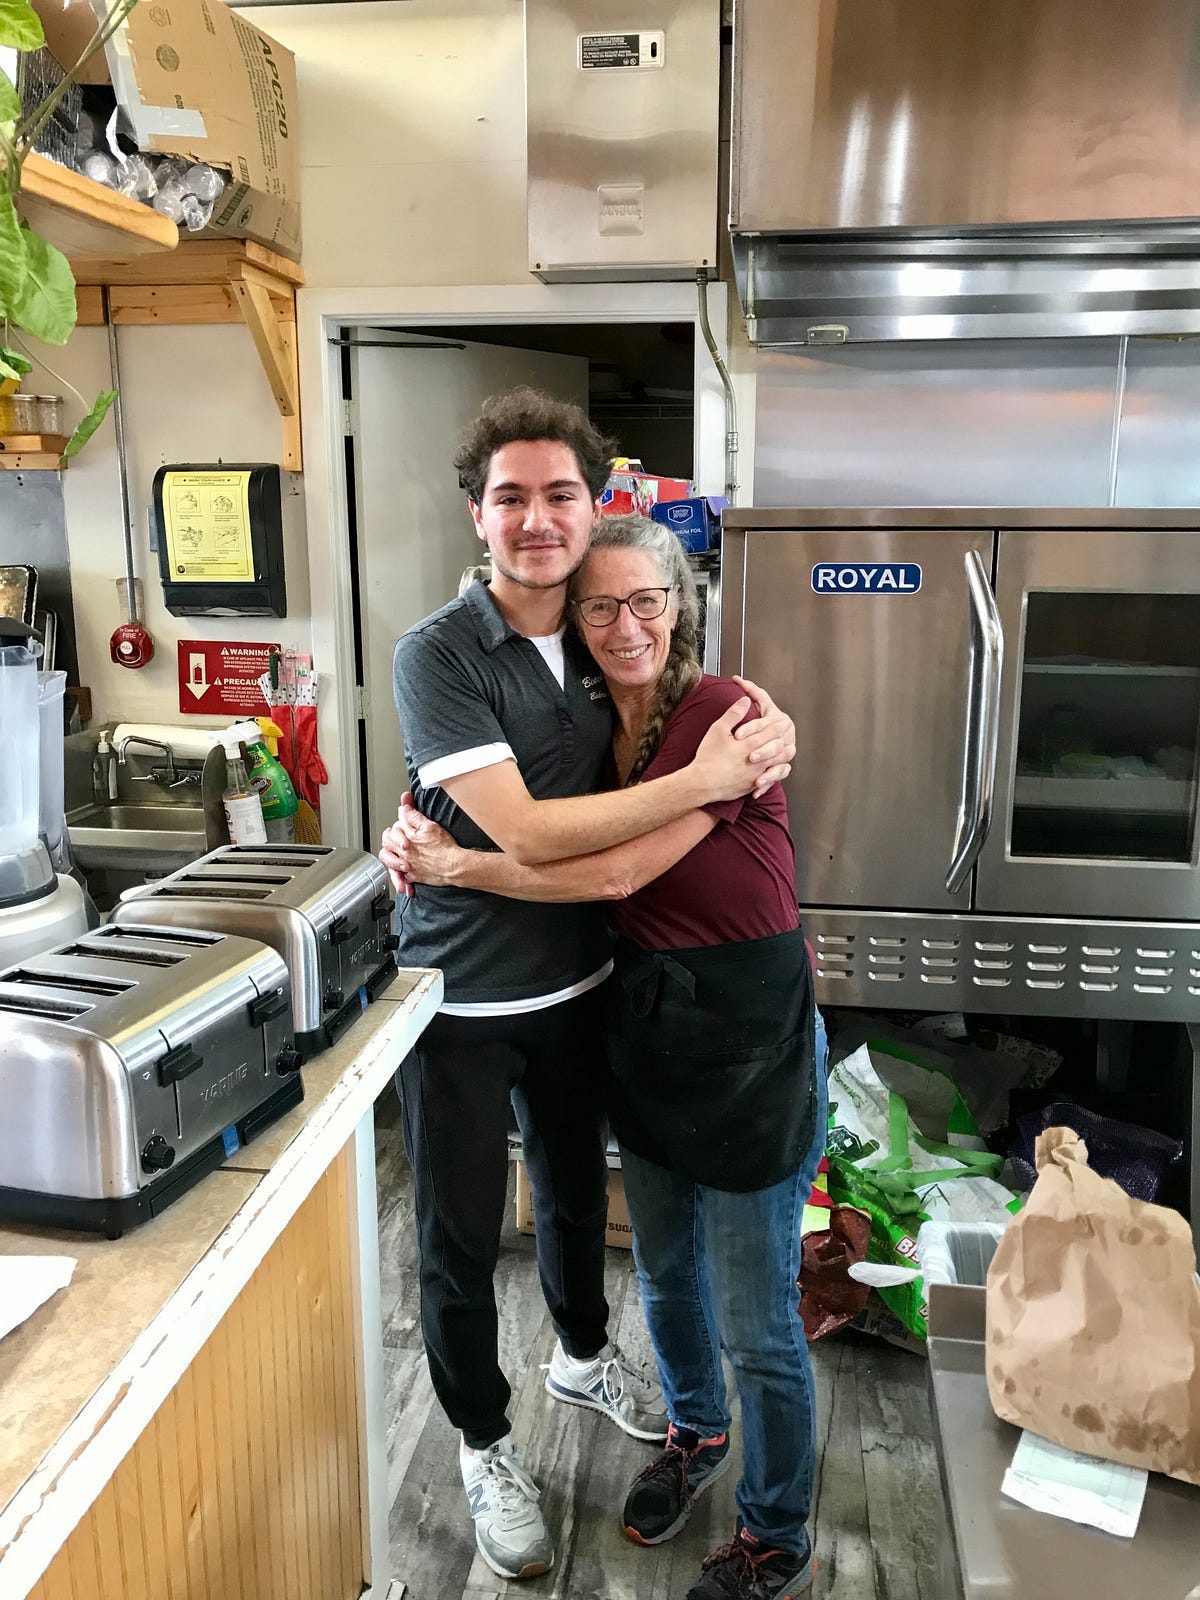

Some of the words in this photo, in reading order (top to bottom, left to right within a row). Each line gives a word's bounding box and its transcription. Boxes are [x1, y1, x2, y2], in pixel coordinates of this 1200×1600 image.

[258, 35, 288, 139] APC20
[817, 568, 915, 589] ROYAL
[223, 678, 257, 686] PRECAU
[467, 1483, 489, 1516] N
